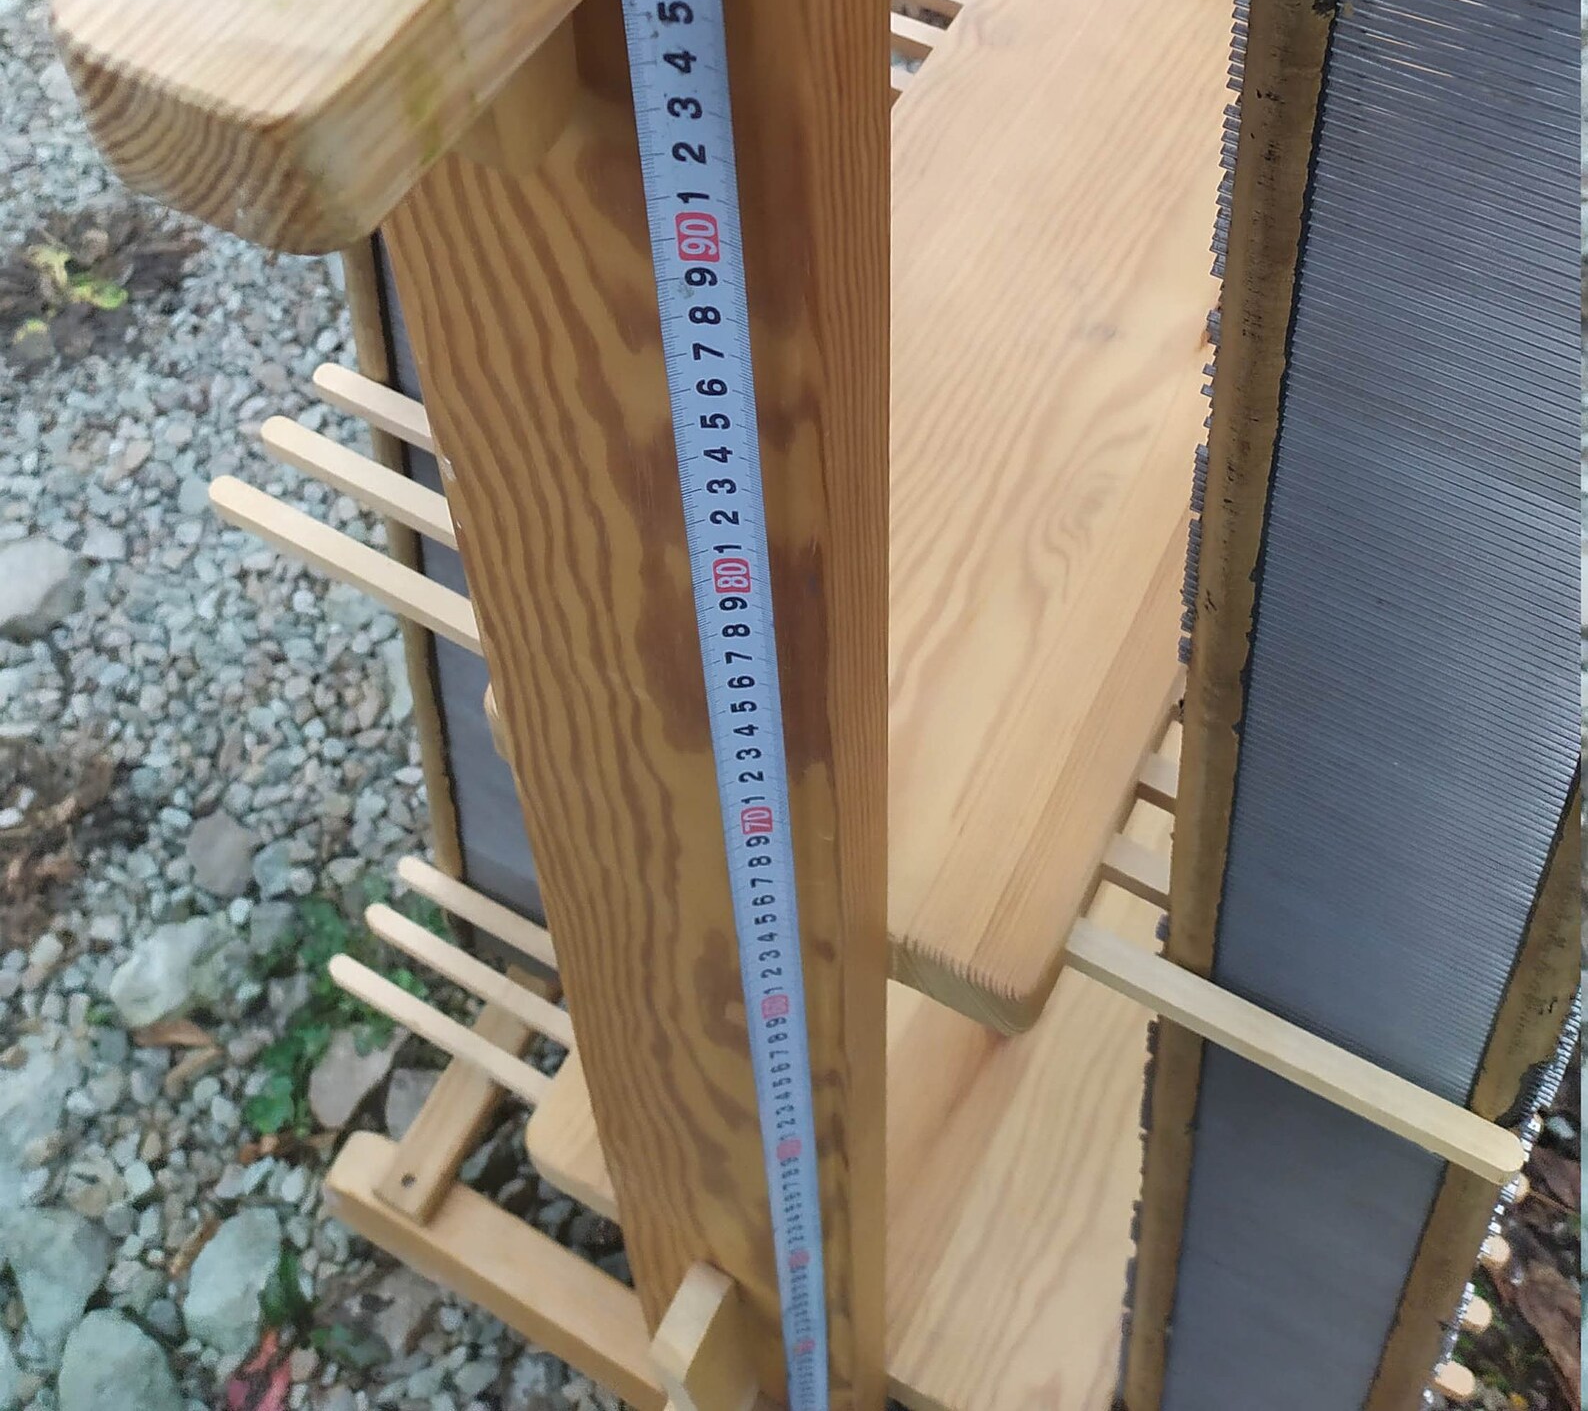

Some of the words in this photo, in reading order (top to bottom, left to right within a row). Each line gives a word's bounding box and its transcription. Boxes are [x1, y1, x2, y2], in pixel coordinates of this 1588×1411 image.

[657, 1, 694, 24] 5
[663, 50, 697, 74] 4
[667, 98, 702, 119] 3
[672, 142, 706, 164] 2
[677, 191, 710, 204] 1
[676, 213, 719, 261] 90
[685, 267, 718, 286] 9
[689, 306, 721, 324] 8
[693, 343, 724, 360] 7
[696, 379, 727, 396] 6
[700, 414, 730, 429] 5
[704, 447, 732, 463] 4
[707, 479, 736, 494] 3
[710, 510, 739, 525] 2
[713, 544, 742, 554] 1
[714, 558, 750, 592] 80
[719, 596, 748, 611] 9
[722, 623, 750, 638] 8
[725, 651, 752, 664] 7
[728, 675, 755, 689] 6
[731, 700, 757, 714] 5
[733, 724, 759, 737] 4
[736, 747, 761, 760] 3
[739, 770, 764, 782] 2
[743, 808, 772, 834] 70
[746, 835, 770, 848] 9
[748, 855, 771, 867] 8
[750, 877, 773, 888] 7
[752, 894, 775, 906] 6
[755, 913, 776, 925] 5
[757, 932, 777, 942] 4
[759, 949, 780, 961] 3
[761, 967, 782, 978] 2
